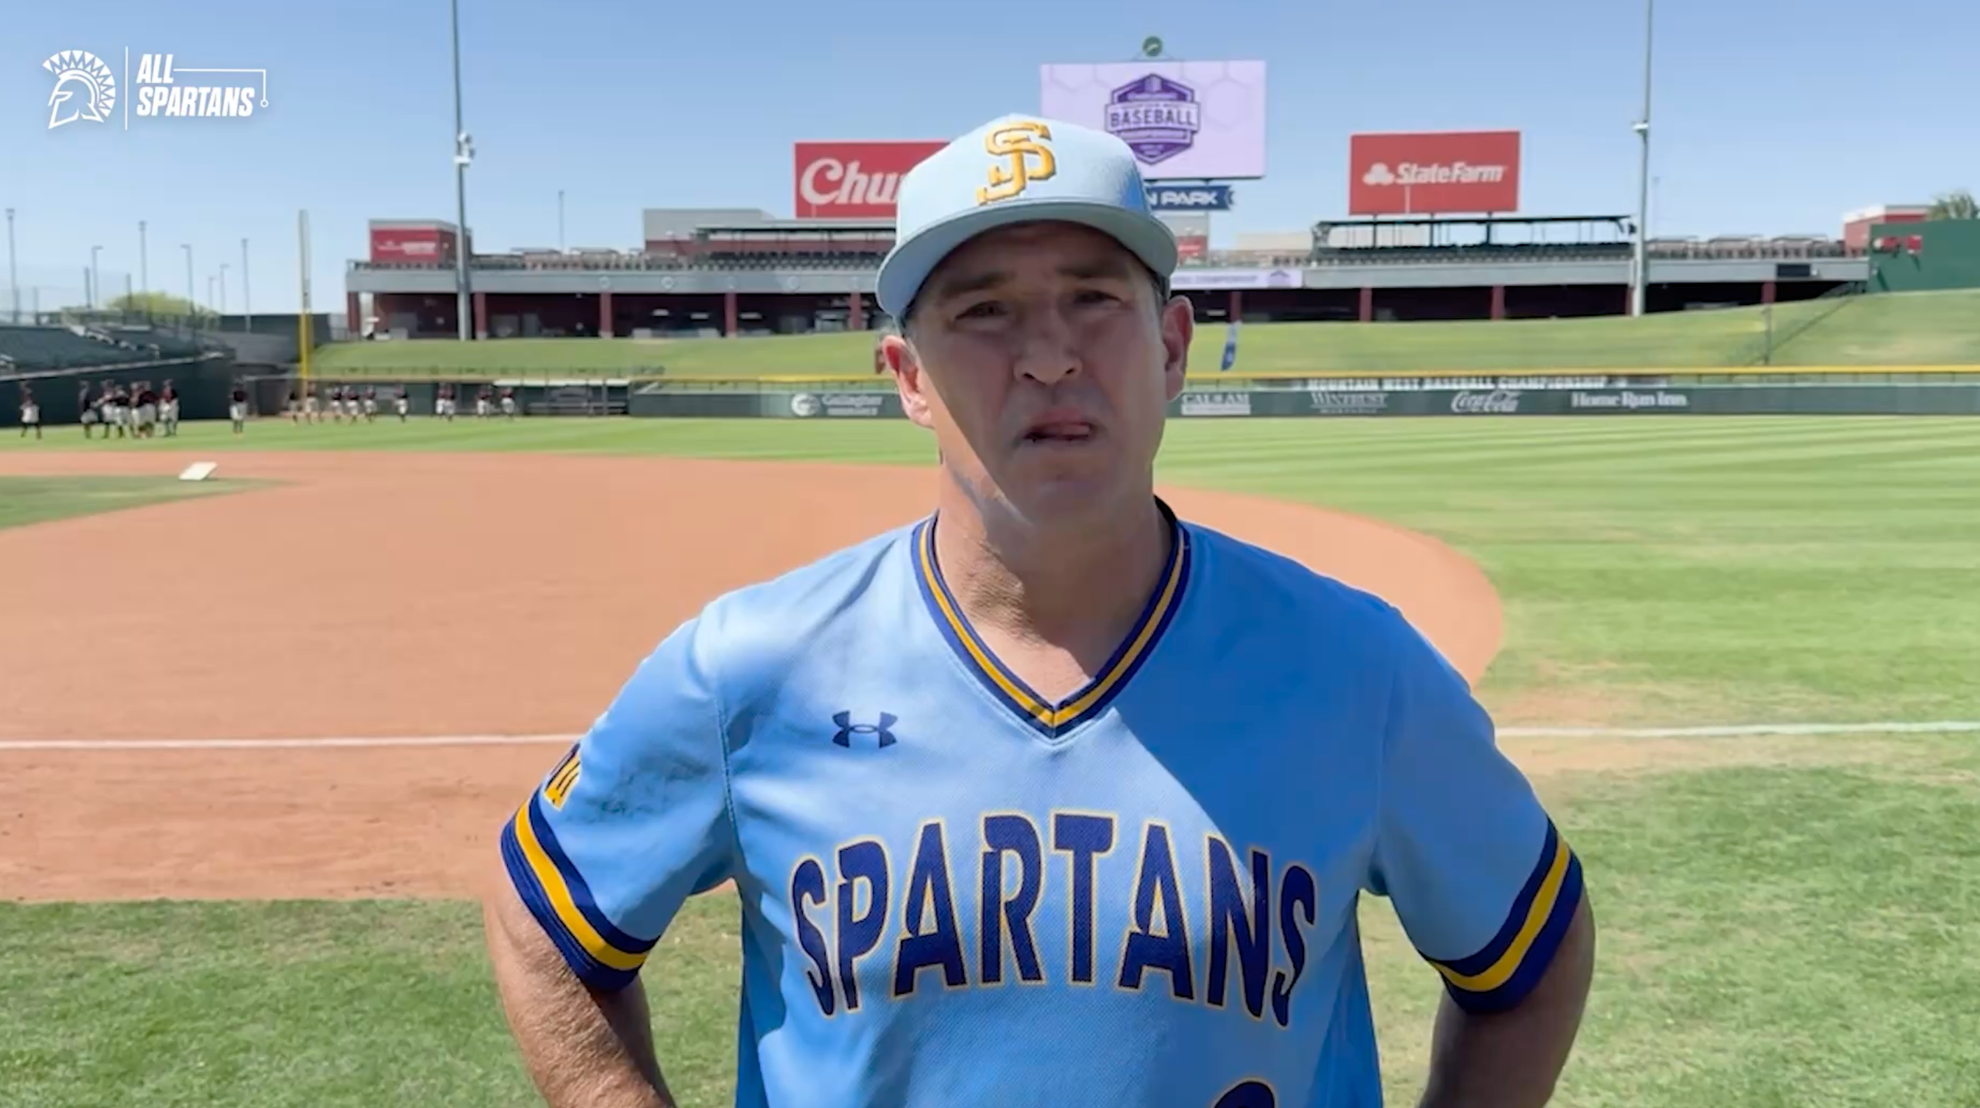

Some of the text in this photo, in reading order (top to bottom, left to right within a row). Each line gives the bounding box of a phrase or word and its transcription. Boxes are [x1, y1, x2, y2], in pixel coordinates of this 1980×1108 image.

[1110, 108, 1196, 128] BASEBALL
[1160, 190, 1218, 206] PARK
[1422, 376, 1494, 390] BASEBALL
[1571, 391, 1687, 408] Home Run Inn
[789, 810, 1317, 1029] SPARTANS
